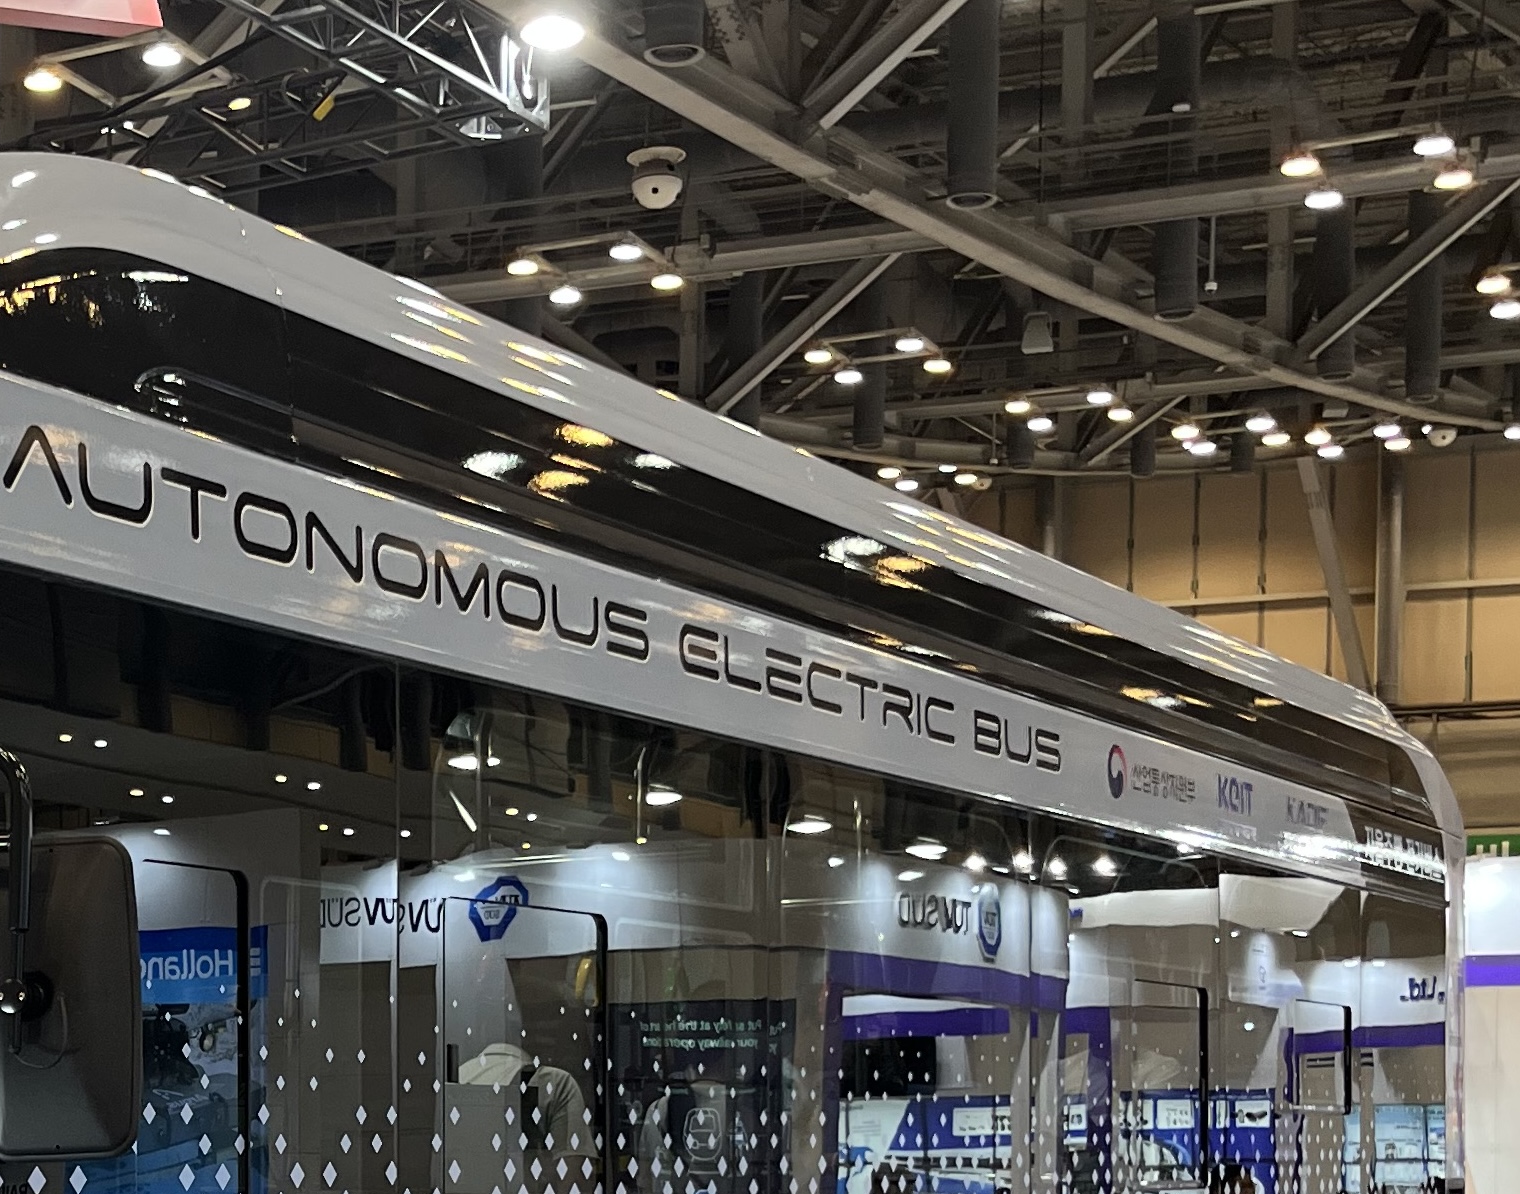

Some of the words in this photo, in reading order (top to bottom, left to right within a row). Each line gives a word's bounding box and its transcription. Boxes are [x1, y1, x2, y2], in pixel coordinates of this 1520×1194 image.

[2, 424, 650, 662] AUTONOMOUS
[679, 624, 956, 745] ELECTRIC
[974, 710, 1062, 772] BUS
